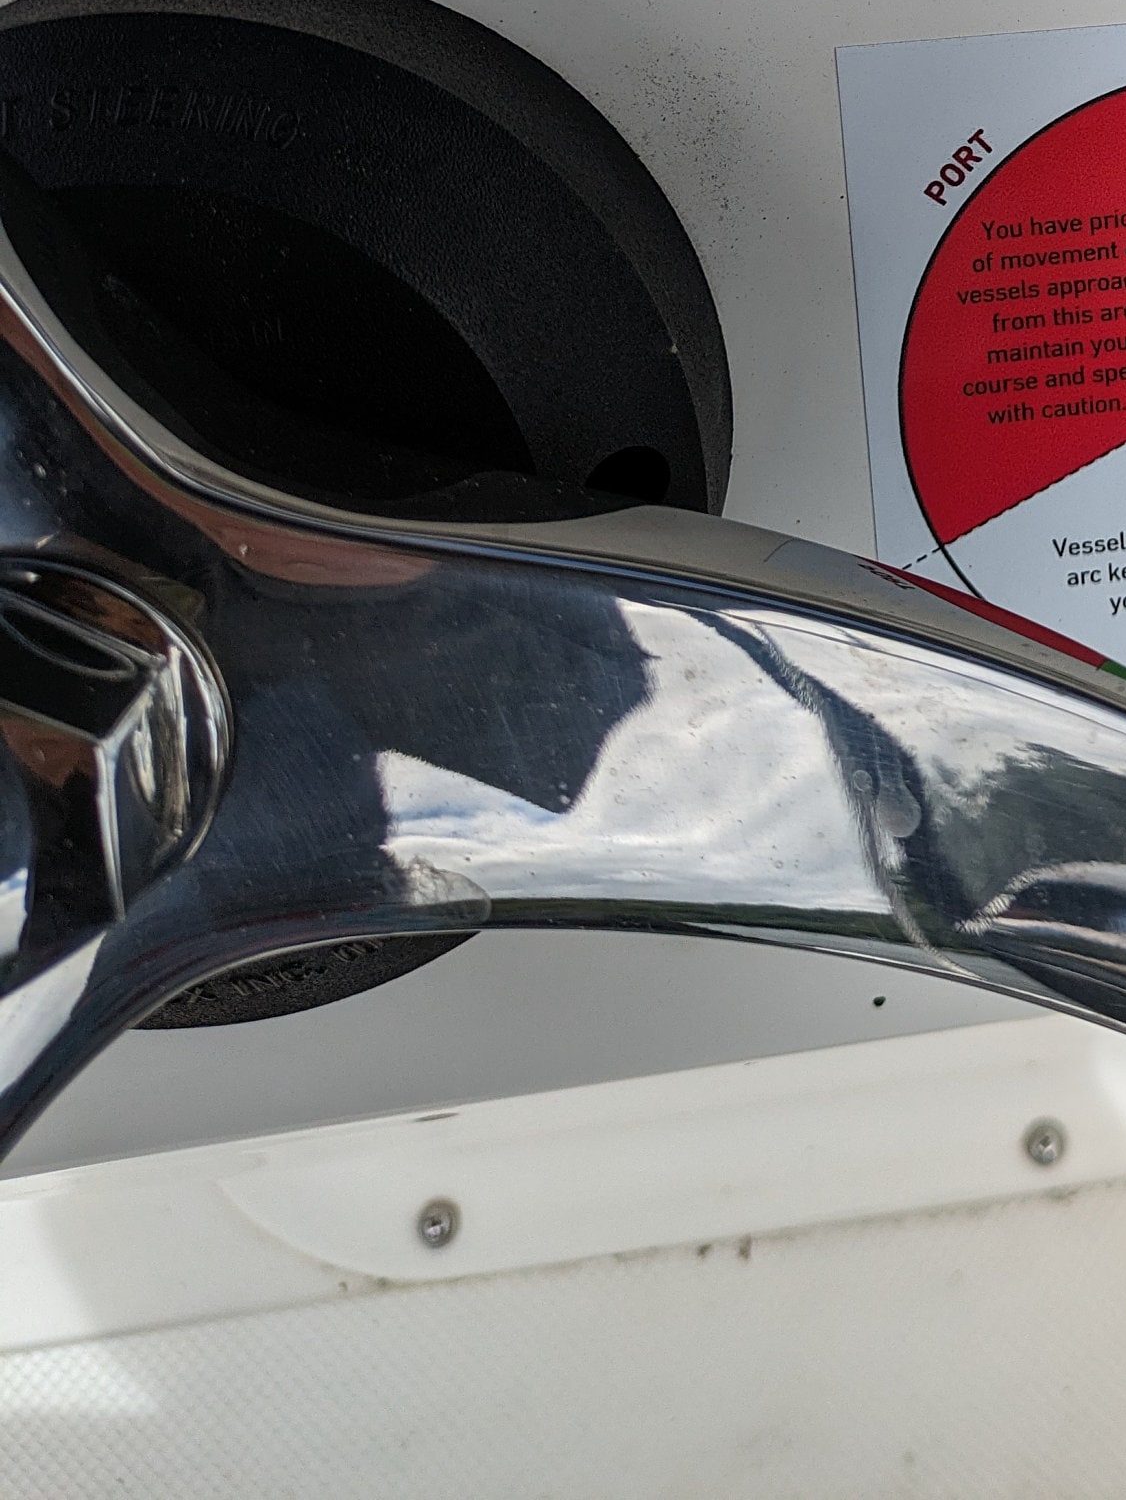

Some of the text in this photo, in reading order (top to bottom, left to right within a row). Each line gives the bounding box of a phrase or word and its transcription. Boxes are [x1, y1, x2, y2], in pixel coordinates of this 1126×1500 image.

[923, 128, 993, 206] PORT
[981, 219, 1024, 241] You
[1029, 215, 1083, 237] have
[971, 251, 994, 273] of
[1000, 241, 1118, 270] movement
[957, 279, 1041, 306] vessels
[992, 313, 1047, 334] from
[1052, 306, 1094, 327] this
[986, 338, 1085, 365] maintain
[962, 375, 1039, 398] course
[1044, 364, 1086, 388] and
[987, 401, 1035, 425] with
[1066, 567, 1103, 587] arc
